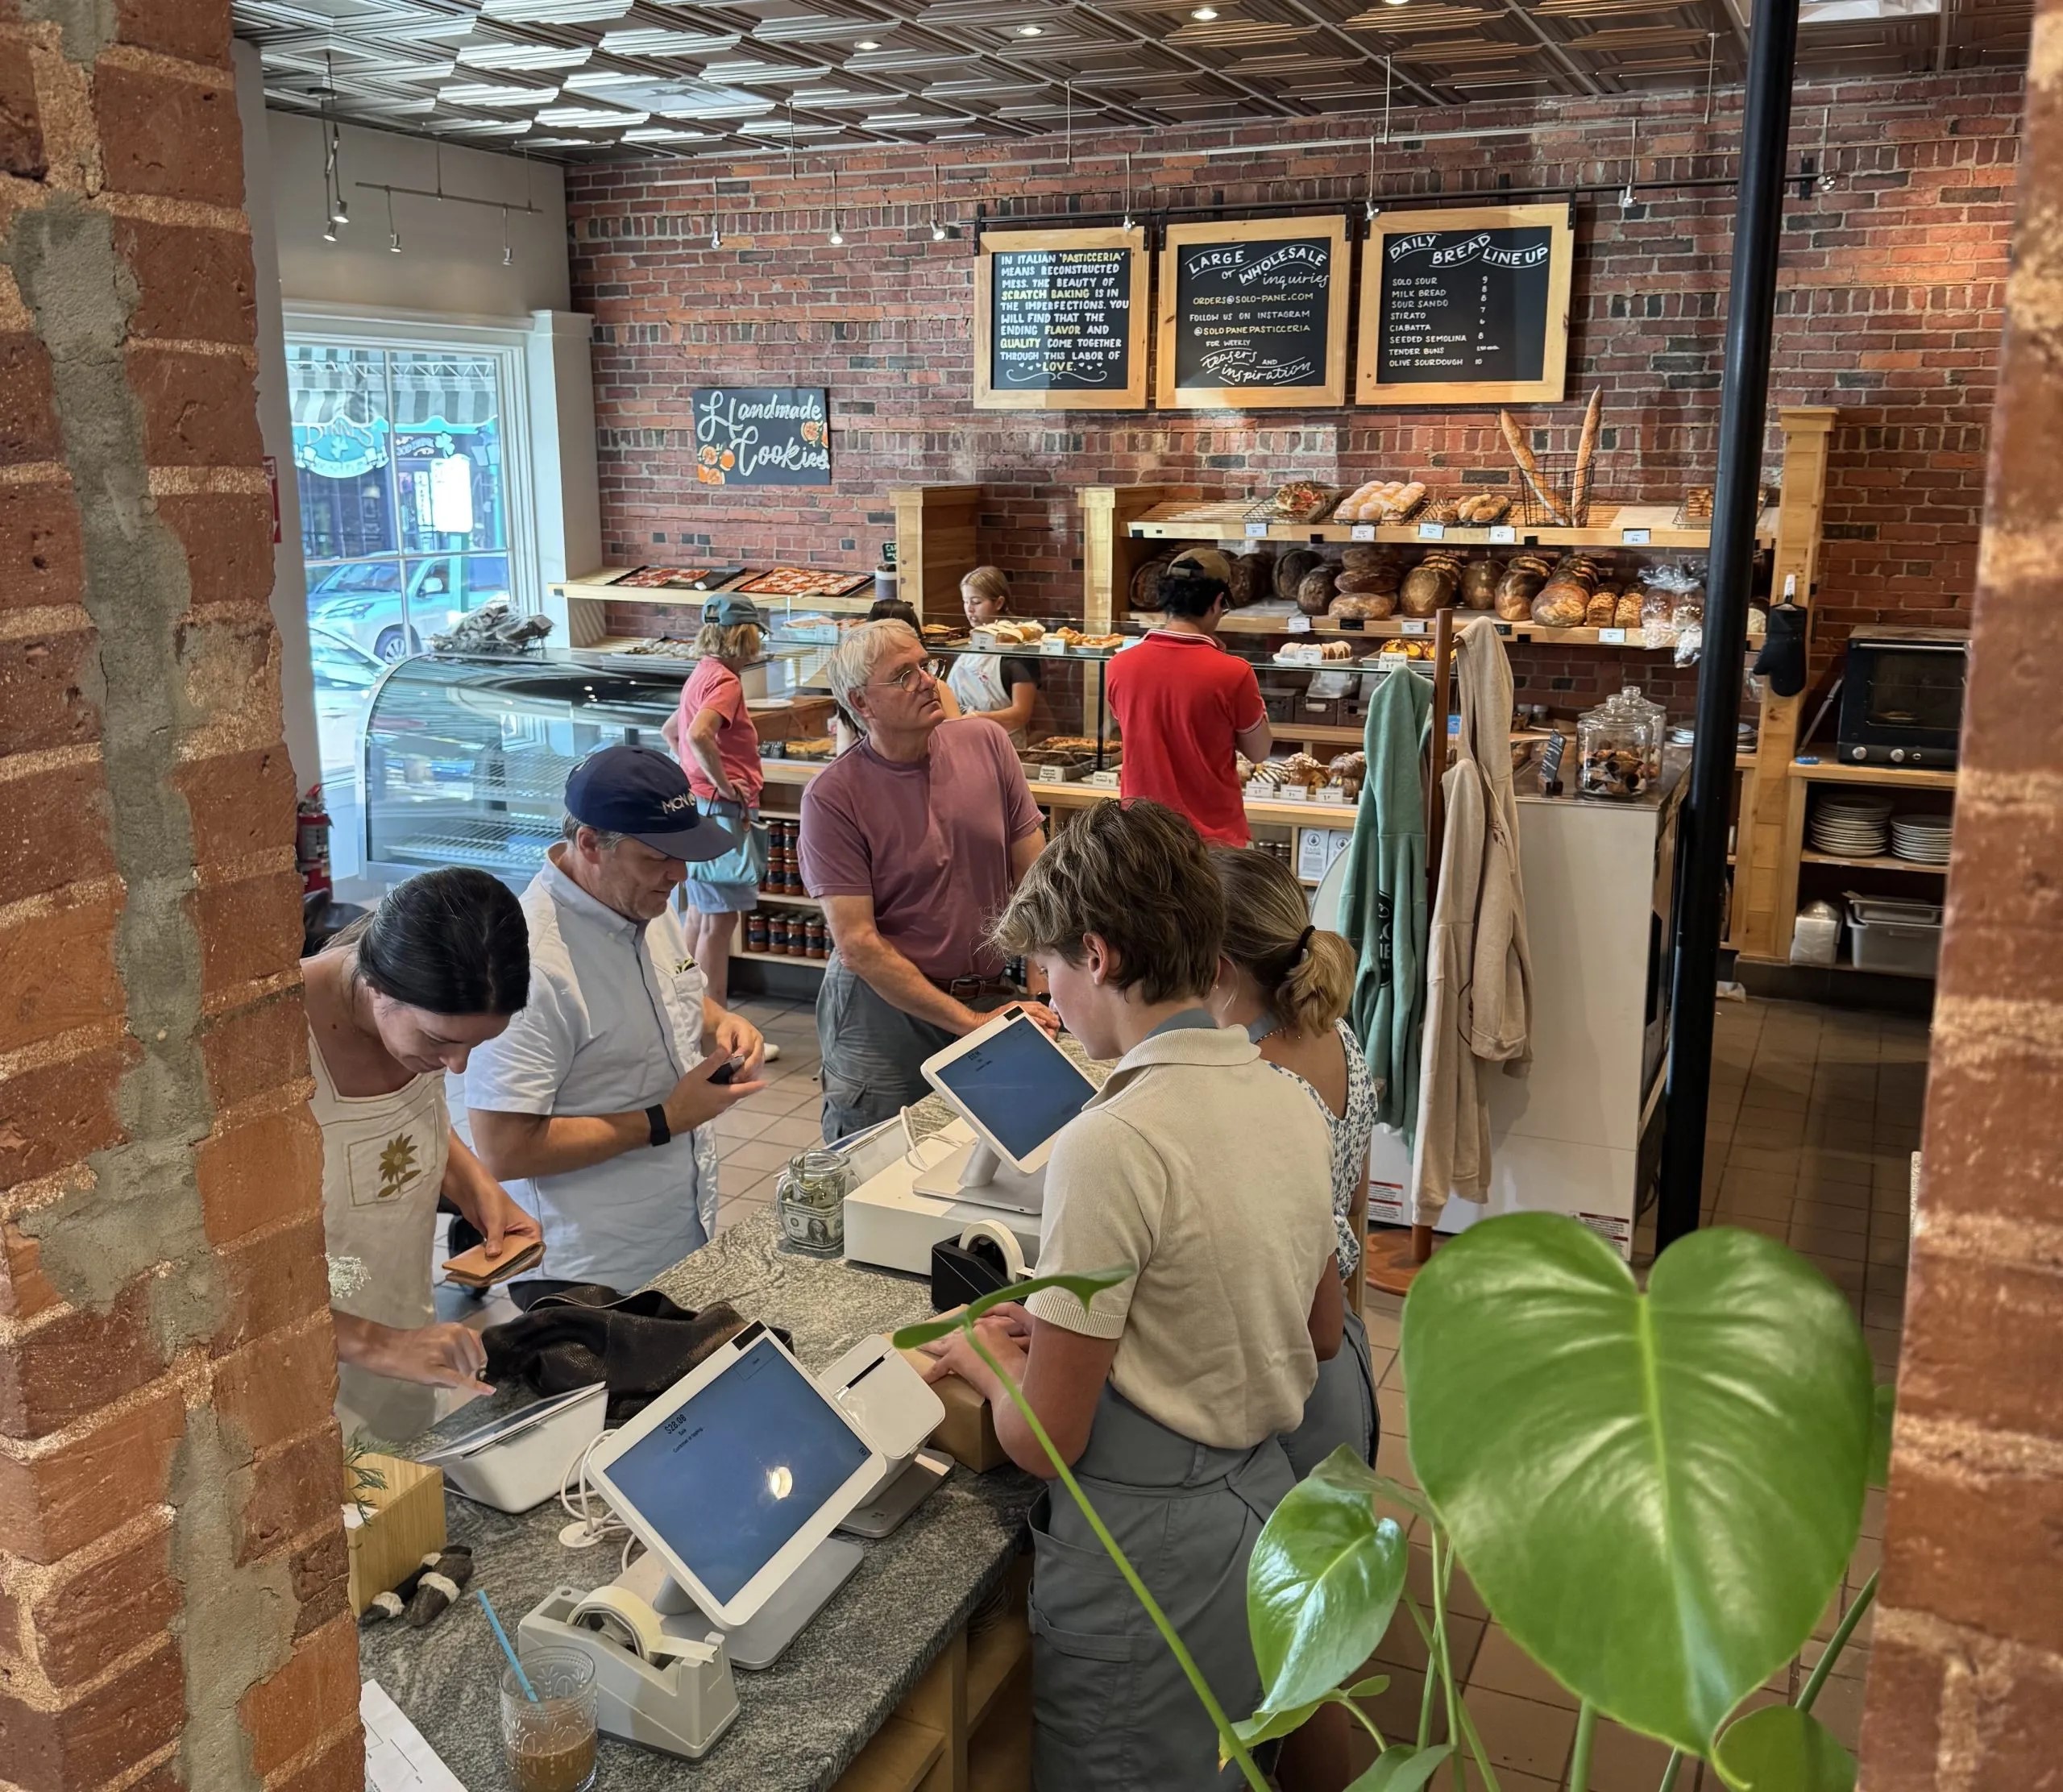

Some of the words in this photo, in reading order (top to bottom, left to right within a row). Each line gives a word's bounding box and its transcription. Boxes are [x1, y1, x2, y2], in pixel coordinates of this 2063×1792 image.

[1390, 235, 1436, 259] DAILY
[1432, 235, 1491, 263] BREAD
[1002, 256, 1012, 264] IN
[1018, 255, 1056, 263] ITALIAN
[1189, 251, 1244, 274] LARGE
[1002, 267, 1035, 276] MEANS
[1041, 264, 1119, 275] RECONSTRUCTED
[1239, 247, 1327, 284] WHOLESALE
[1002, 280, 1028, 288] MESS.
[1032, 279, 1049, 287] THE
[1057, 278, 1097, 287] BEAUTY
[1102, 278, 1115, 286] OF
[1263, 273, 1329, 289] inquiries
[1483, 276, 1488, 284] 9
[1002, 291, 1046, 301] SCRATCH
[1052, 289, 1090, 298] BAKING
[1095, 289, 1104, 297] IS
[1107, 289, 1119, 297] IN
[1193, 292, 1313, 305] ORDERS@SOLO-PANE.COM
[1001, 303, 1019, 311] THE
[1025, 301, 1106, 310] IMPERFECTIONS.
[1110, 300, 1128, 309] YOU
[1418, 300, 1448, 308] SANDO
[1001, 315, 1024, 323] WILL
[1027, 314, 1050, 323] FIND
[1054, 313, 1079, 322] THAT
[1085, 313, 1104, 321] THE
[1258, 310, 1310, 319] INSTAGRAM
[1390, 312, 1426, 320] STIRATO
[1001, 326, 1037, 335] ENDING
[1044, 326, 1081, 334] FLAVOR
[1087, 326, 1109, 334] AND
[1000, 338, 1040, 349] QUALITY
[1048, 339, 1072, 348] COME
[1077, 338, 1122, 347] TOGETHER
[1000, 352, 1039, 360] THROUGH
[1044, 352, 1065, 360] THIS
[1073, 351, 1103, 360] LABOR
[1109, 351, 1120, 359] OF
[1202, 351, 1257, 368] teasers
[1043, 363, 1077, 371] LOVE.
[1222, 362, 1311, 382] inspiration
[697, 391, 822, 442] Handmade
[729, 425, 830, 476] Cookies
